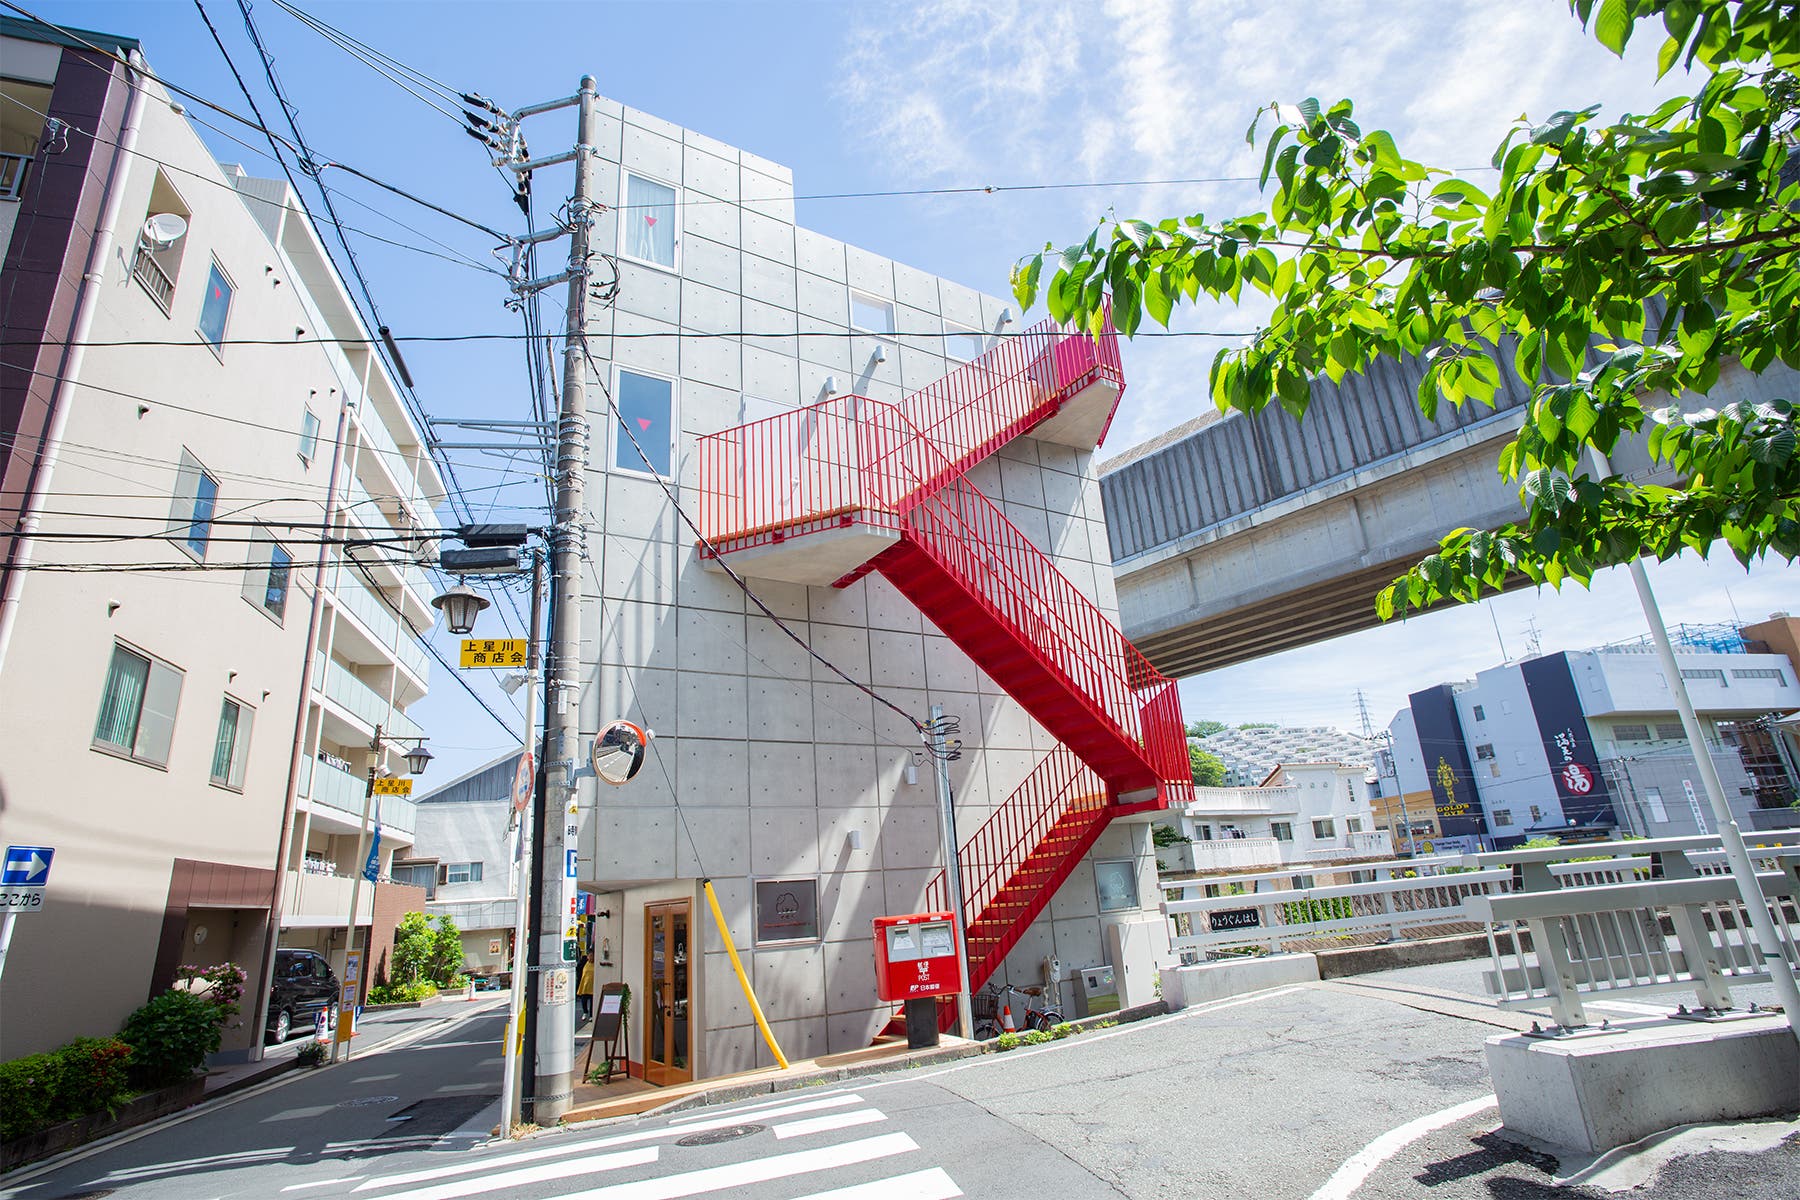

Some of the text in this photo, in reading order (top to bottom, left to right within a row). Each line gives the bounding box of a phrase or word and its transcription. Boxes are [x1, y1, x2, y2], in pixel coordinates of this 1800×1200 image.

[464, 641, 514, 652] 上星川
[474, 652, 523, 663] 商店会
[1437, 803, 1470, 813] GOLD'S
[0, 893, 41, 906] ここから
[1211, 913, 1257, 927] りょうぐんはし
